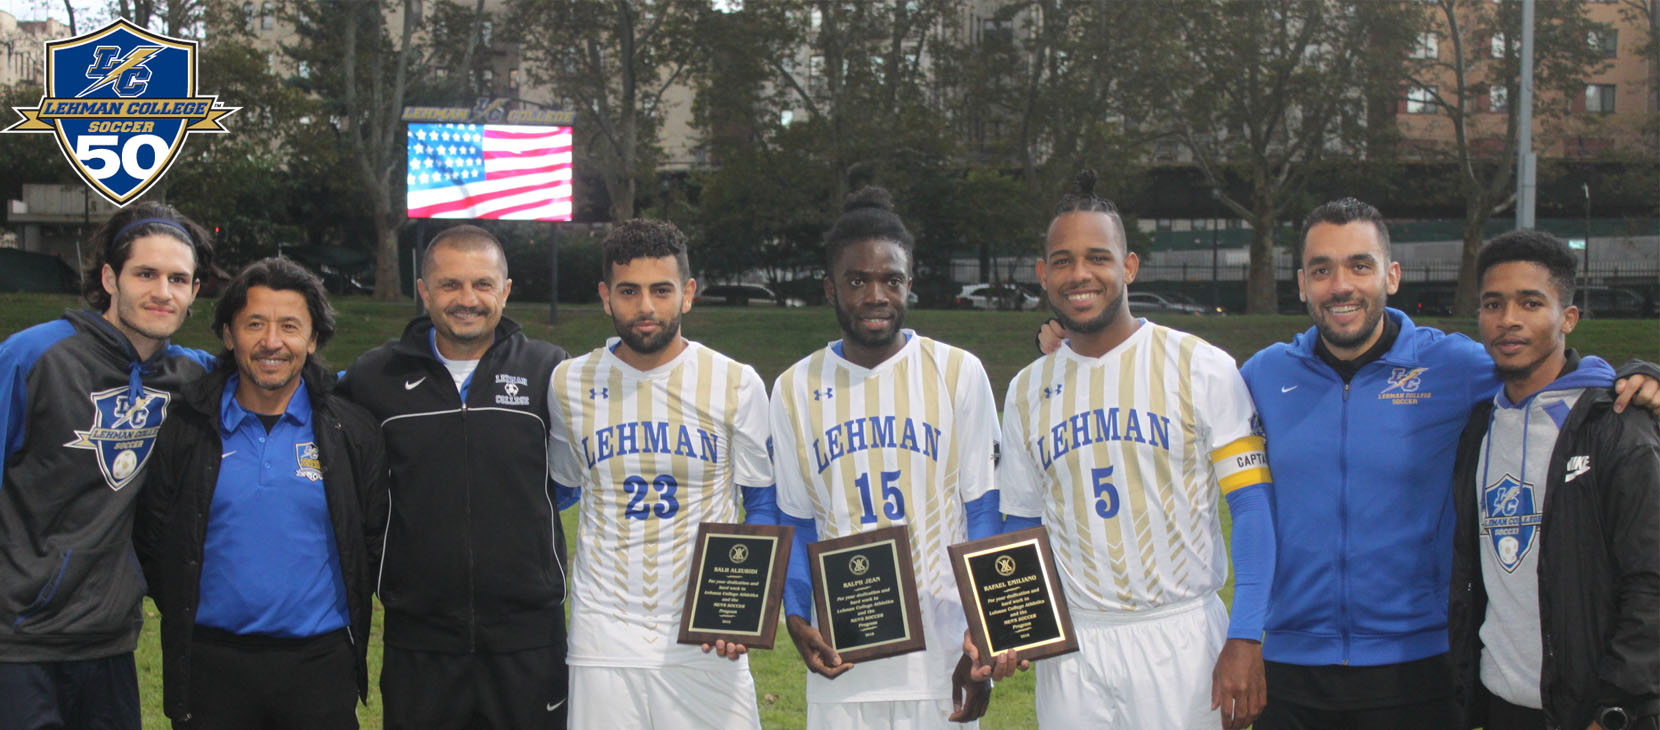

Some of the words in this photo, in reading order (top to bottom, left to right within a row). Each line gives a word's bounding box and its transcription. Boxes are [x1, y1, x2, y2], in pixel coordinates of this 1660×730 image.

[402, 107, 471, 120] LEHMAN
[507, 110, 576, 122] COLLEGE
[495, 374, 528, 386] LEHMAN
[495, 395, 530, 405] COLLEGE
[93, 430, 134, 439] LEHMAN
[1037, 408, 1170, 471] LEHMAN
[114, 440, 144, 449] SOCCER
[582, 421, 718, 470] LEHMAN
[813, 416, 942, 474] LEHMAN
[1566, 456, 1590, 472] NIKE
[623, 474, 680, 520] 23
[854, 470, 905, 524] 15
[1091, 465, 1120, 519] 5
[843, 580, 863, 588] RALPH
[865, 576, 881, 584] JEAN
[984, 582, 1006, 591] RAFAEL
[1007, 575, 1037, 586] EMILIANO
[1007, 591, 1030, 599] dedication
[1018, 613, 1037, 621] SOCCER
